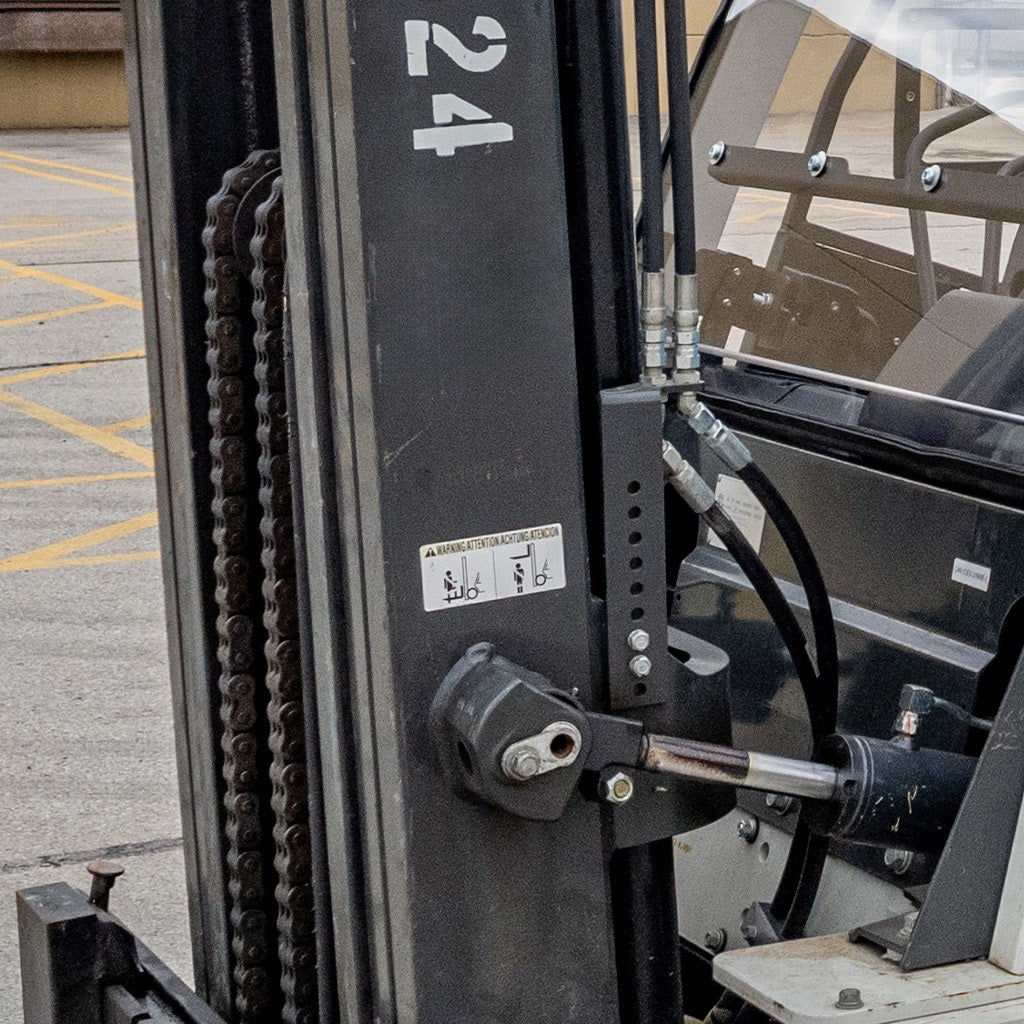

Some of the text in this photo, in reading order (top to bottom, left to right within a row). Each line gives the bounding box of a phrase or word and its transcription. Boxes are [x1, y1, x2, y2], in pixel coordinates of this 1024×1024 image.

[437, 541, 466, 555] WARNING
[467, 535, 499, 550] ATTENTION
[499, 530, 529, 545] ACHTUNG
